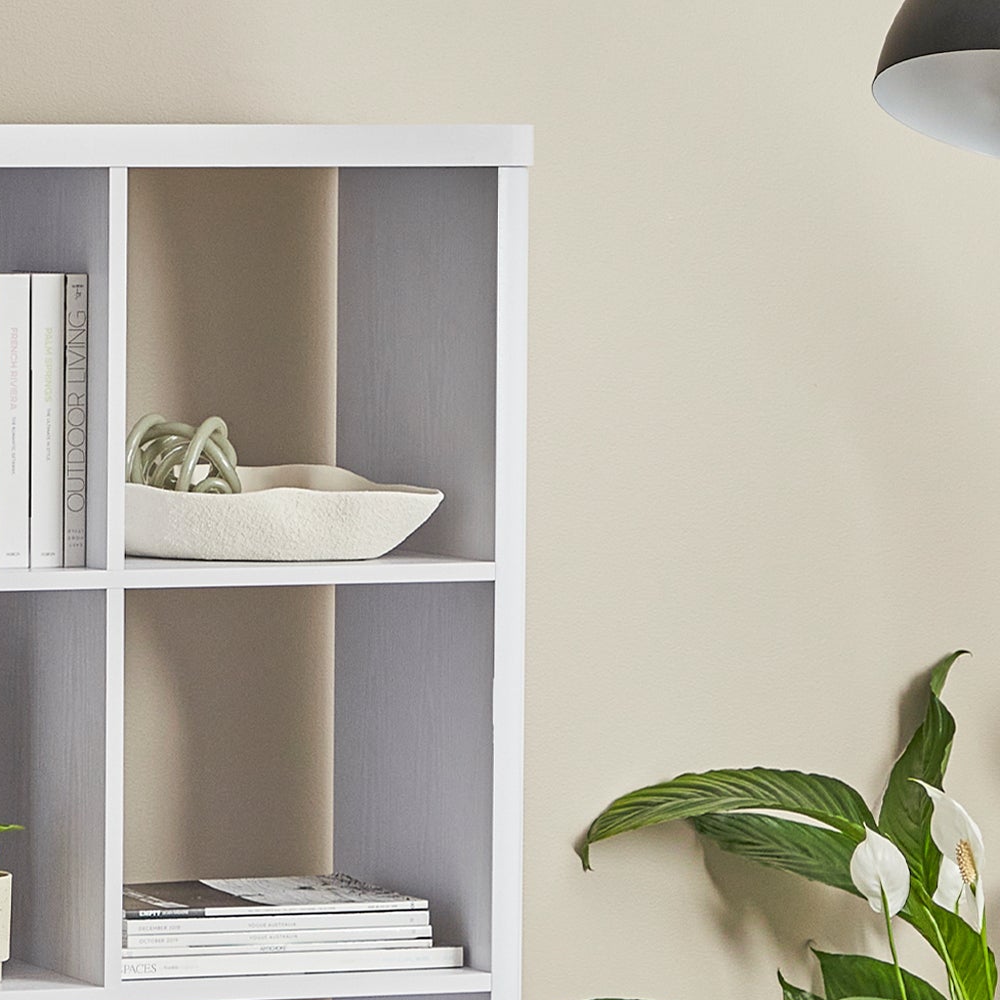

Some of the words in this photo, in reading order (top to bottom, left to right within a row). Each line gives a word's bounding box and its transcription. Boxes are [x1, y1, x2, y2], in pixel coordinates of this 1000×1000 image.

[9, 327, 18, 368] FRENCH
[44, 327, 53, 354] PALM
[67, 310, 87, 383] LIVING
[9, 370, 18, 410] RIVIERA
[44, 357, 53, 402] SPRINGS
[66, 392, 86, 513] OUTDOOR
[121, 963, 157, 975] PACES
